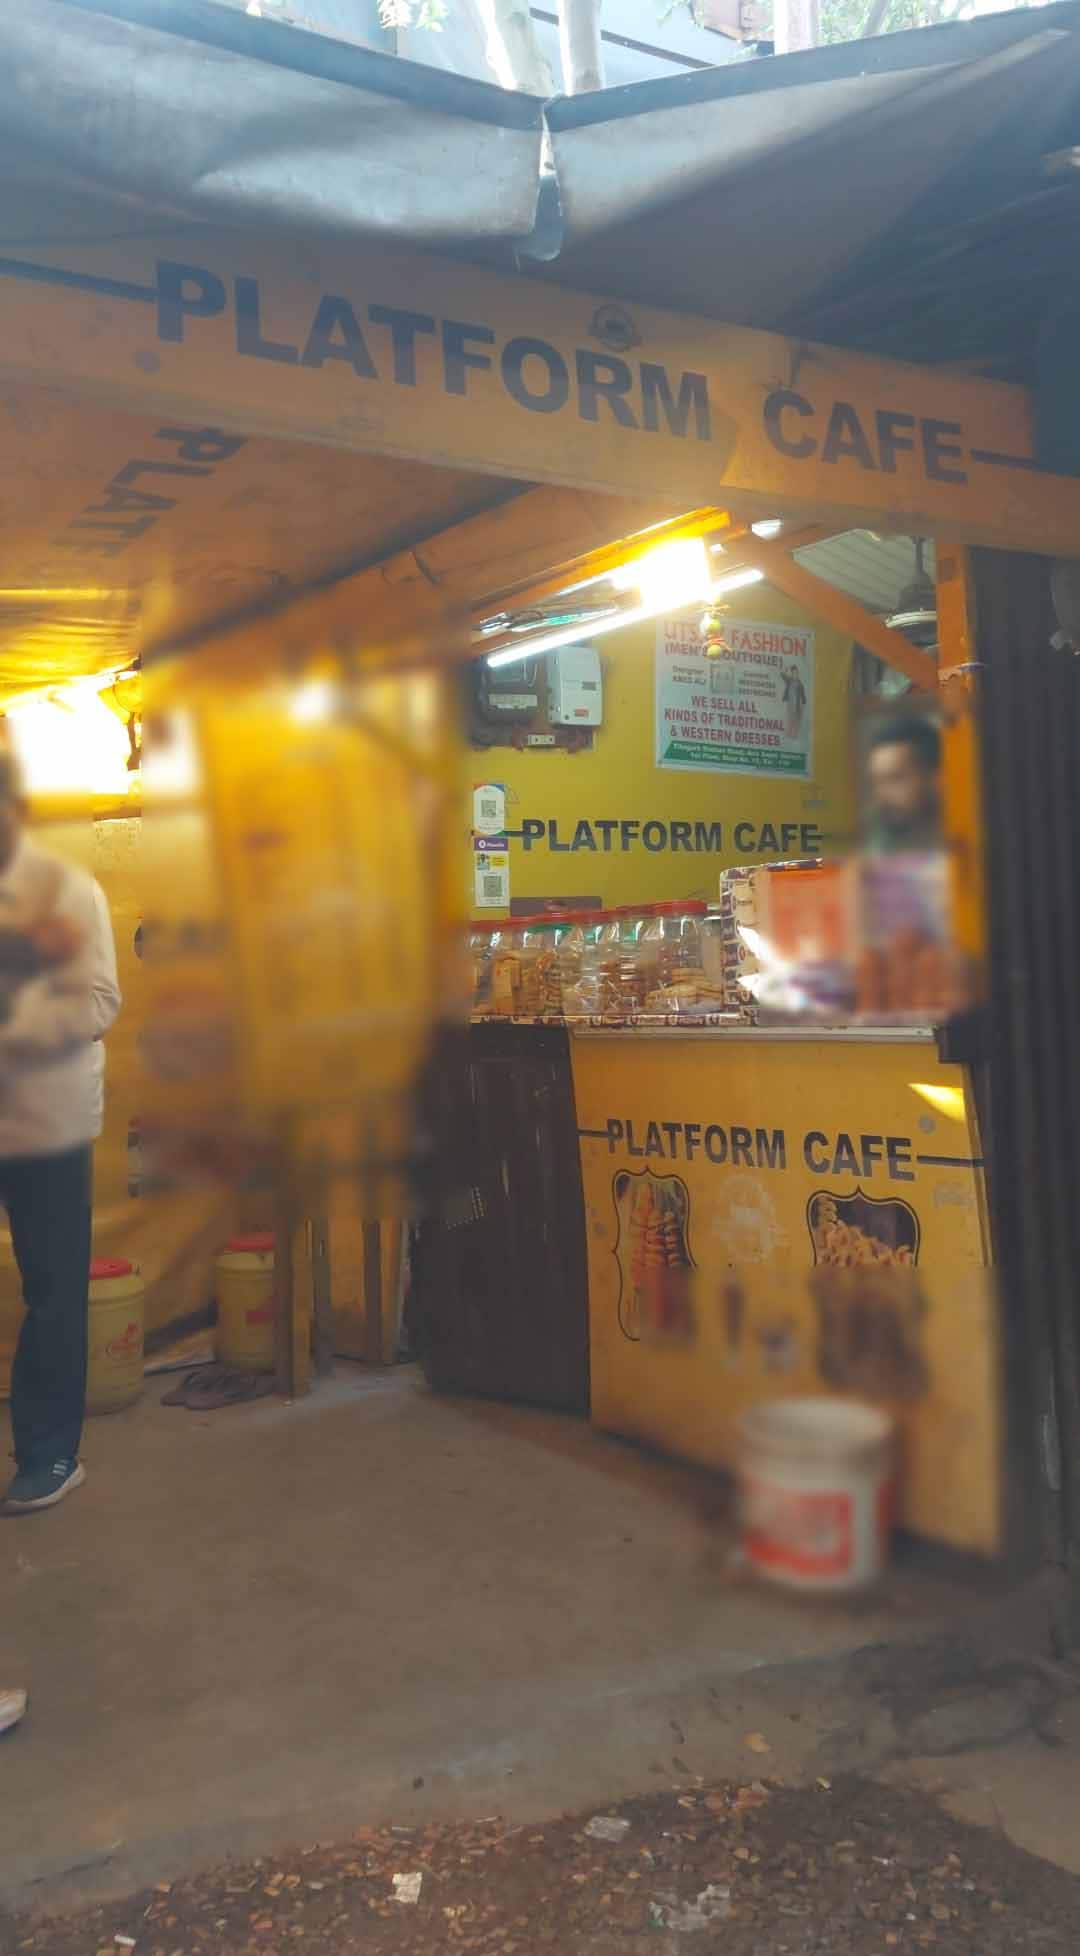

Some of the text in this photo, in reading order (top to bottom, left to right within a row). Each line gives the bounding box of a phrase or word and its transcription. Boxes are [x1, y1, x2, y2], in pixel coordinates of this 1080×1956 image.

[155, 259, 968, 484] PLATFORM CAFE
[664, 622, 806, 657] UTS FASHION
[713, 647, 784, 671] OUTIQUE)
[691, 695, 758, 713] WE SELL ALL
[664, 707, 784, 731] KINDS OF TRADITIONAL
[670, 724, 781, 746] & WESTERN DRESSES
[521, 818, 823, 852] PLATFORM CAFE
[606, 1118, 915, 1182] PLATFORM CAFE
